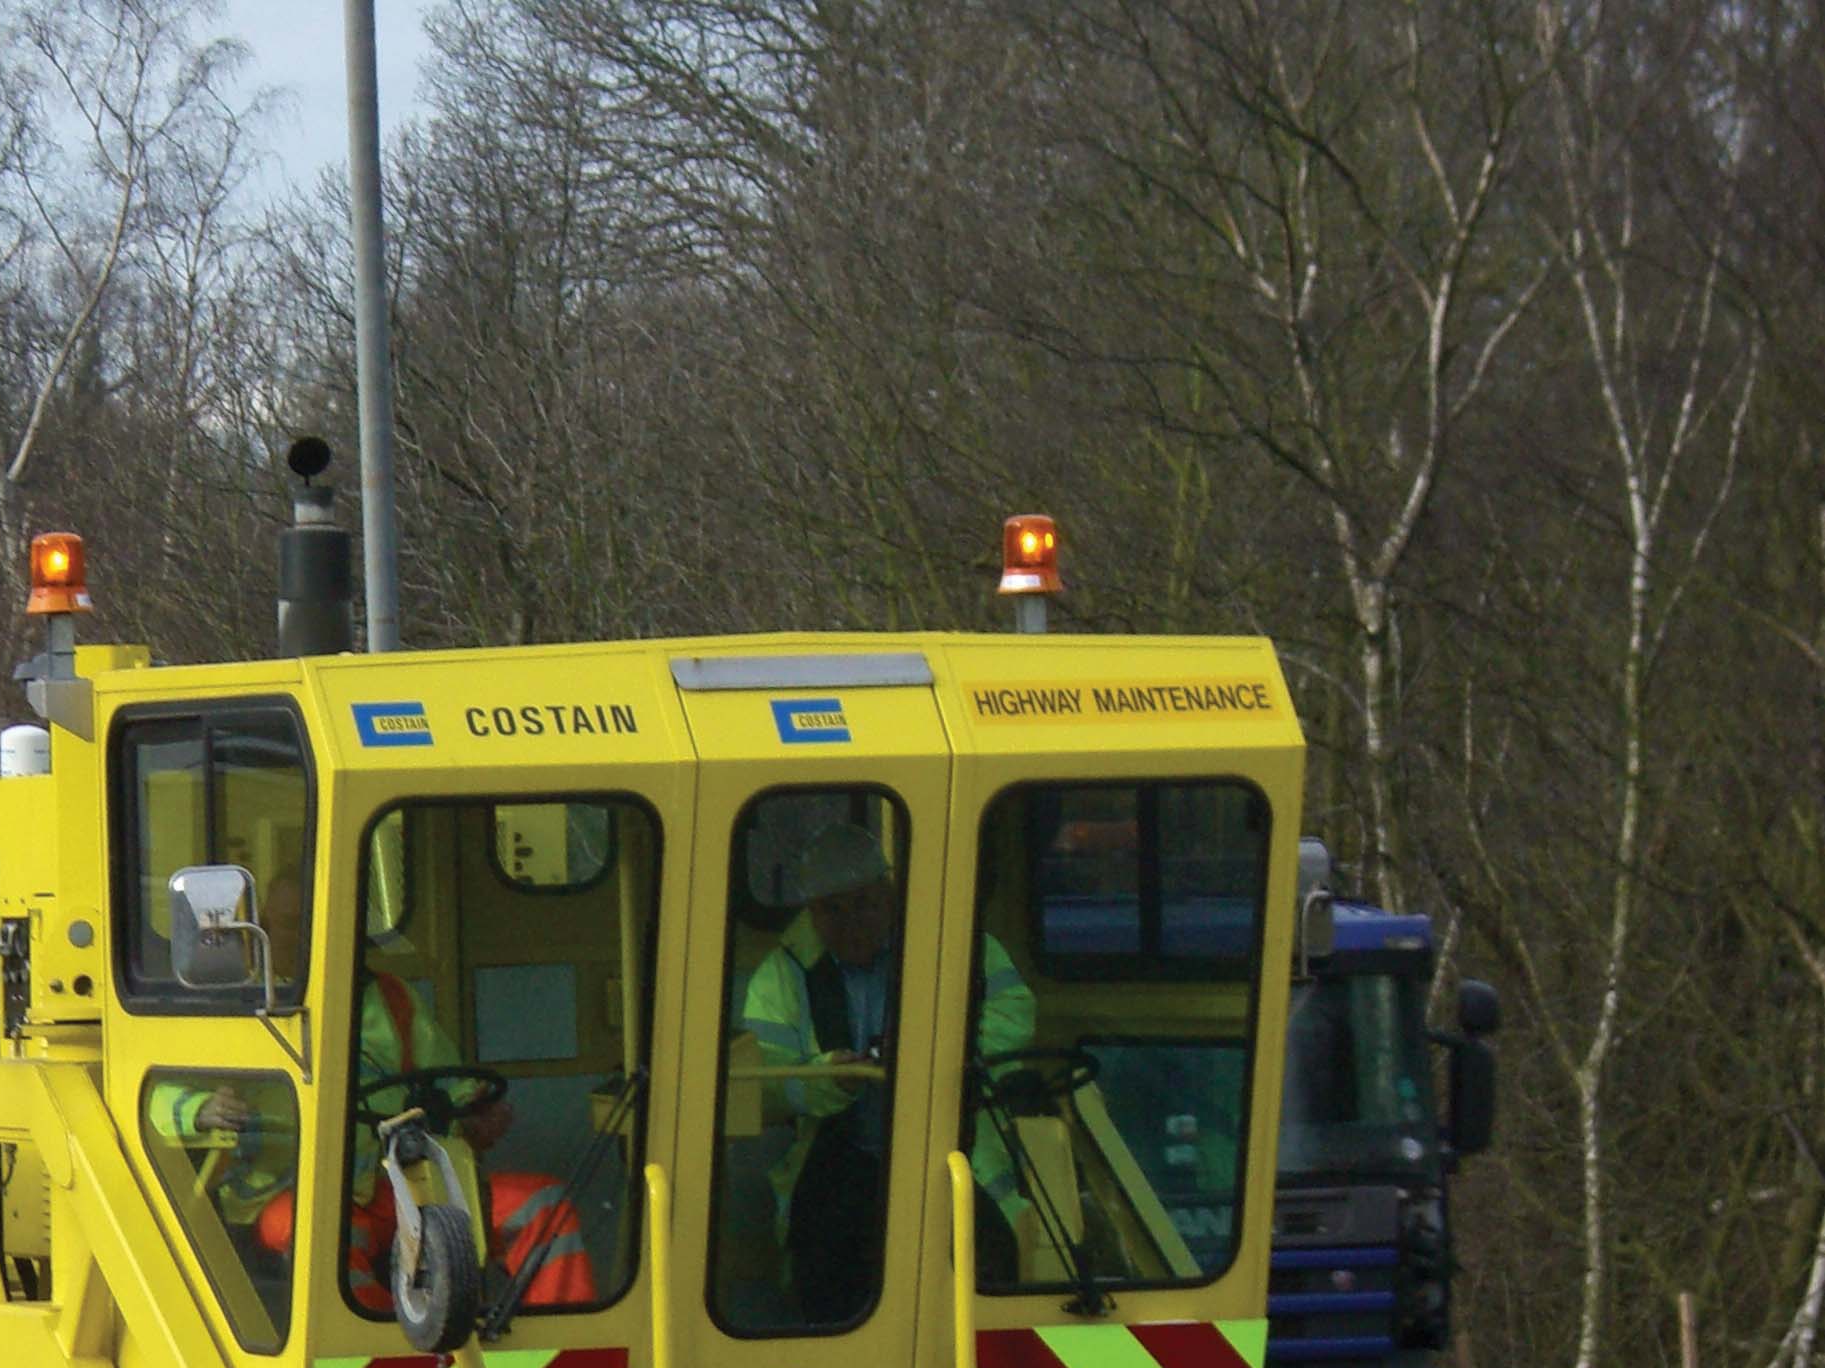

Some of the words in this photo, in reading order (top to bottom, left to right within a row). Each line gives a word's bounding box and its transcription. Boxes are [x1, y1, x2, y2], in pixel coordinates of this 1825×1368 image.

[974, 685, 1082, 717] HIGHWAY
[1094, 683, 1272, 714] MAINTENANCE
[379, 715, 430, 732] COSTAIN
[465, 704, 639, 737] COSTAIN
